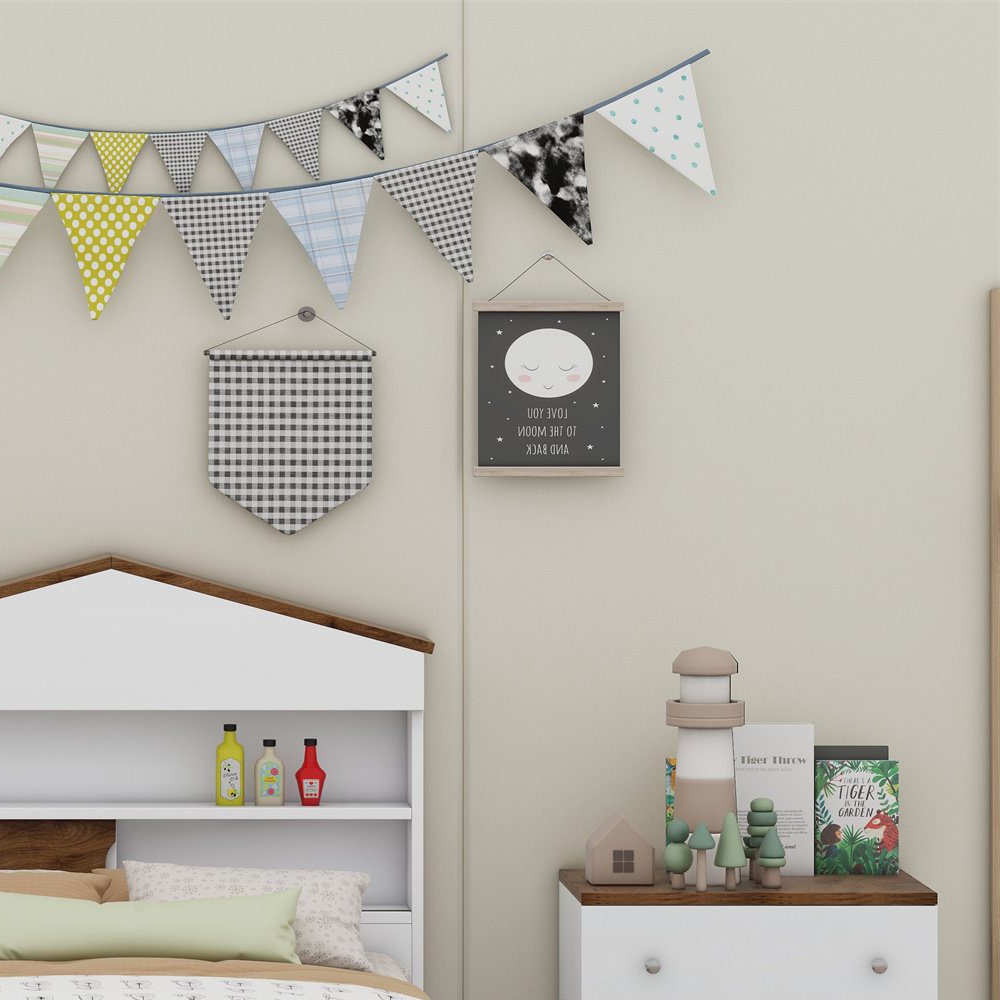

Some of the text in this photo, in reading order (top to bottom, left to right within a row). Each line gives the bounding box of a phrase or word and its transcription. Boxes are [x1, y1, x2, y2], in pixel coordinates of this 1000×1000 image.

[740, 755, 807, 764] Tiger Throw
[837, 784, 875, 801] TIGER
[838, 807, 874, 818] GARDEN
